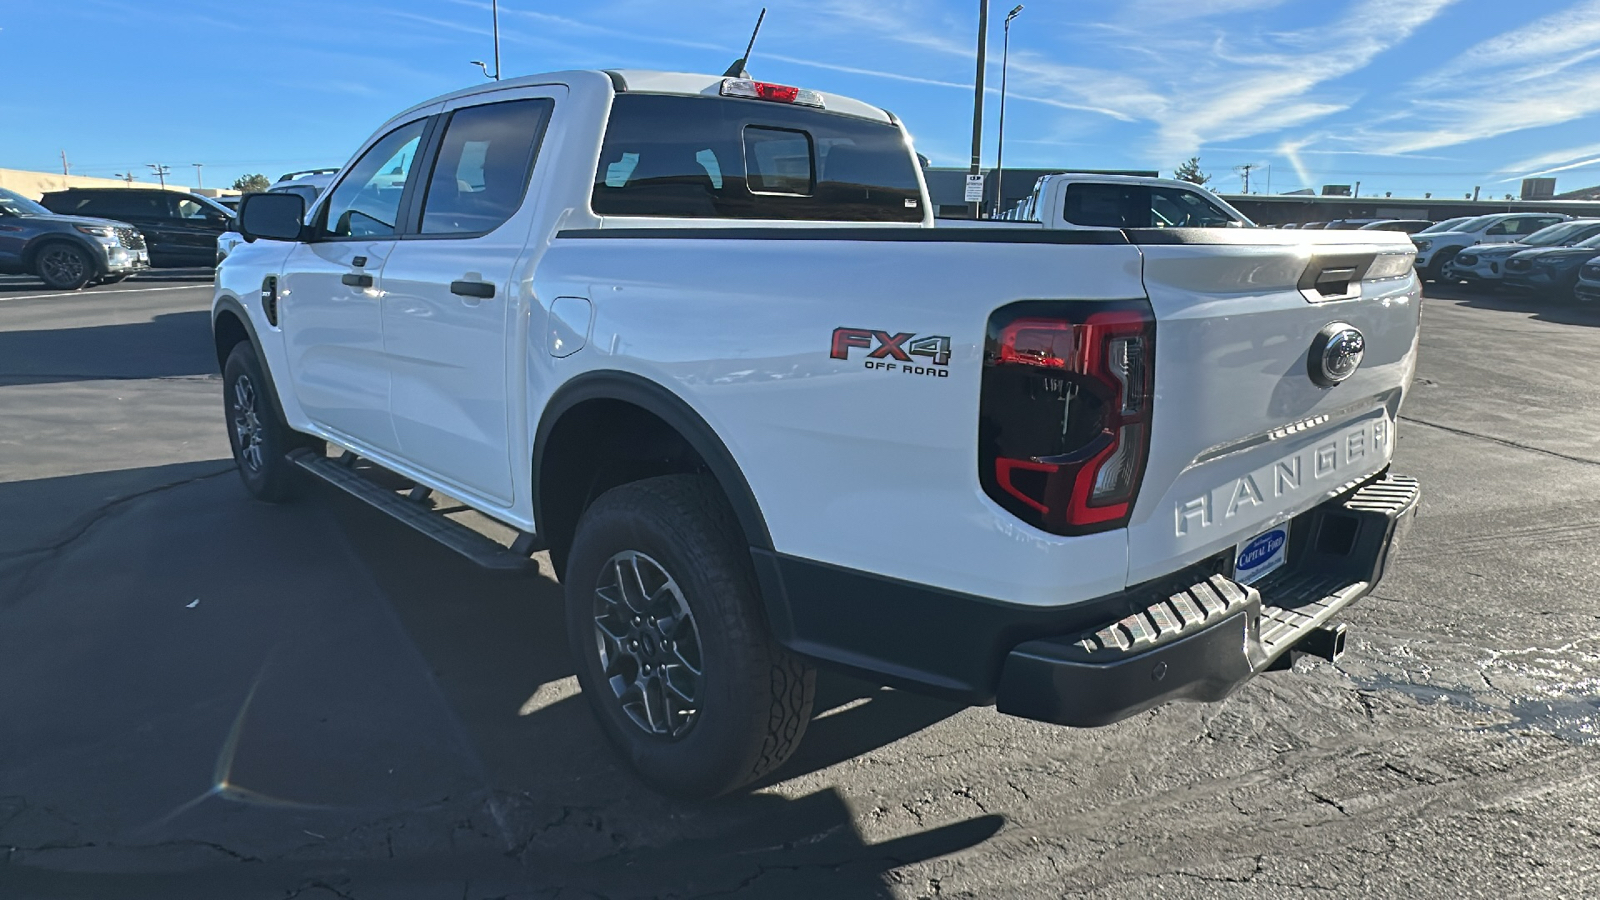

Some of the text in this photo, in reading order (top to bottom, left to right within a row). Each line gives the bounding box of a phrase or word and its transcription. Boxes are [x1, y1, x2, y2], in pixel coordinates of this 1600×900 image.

[830, 327, 951, 366] FX4
[865, 361, 949, 378] OFF ROAD
[1174, 419, 1388, 538] RANGER
[1239, 546, 1266, 567] CAPITAL
[1267, 536, 1283, 552] FORD
